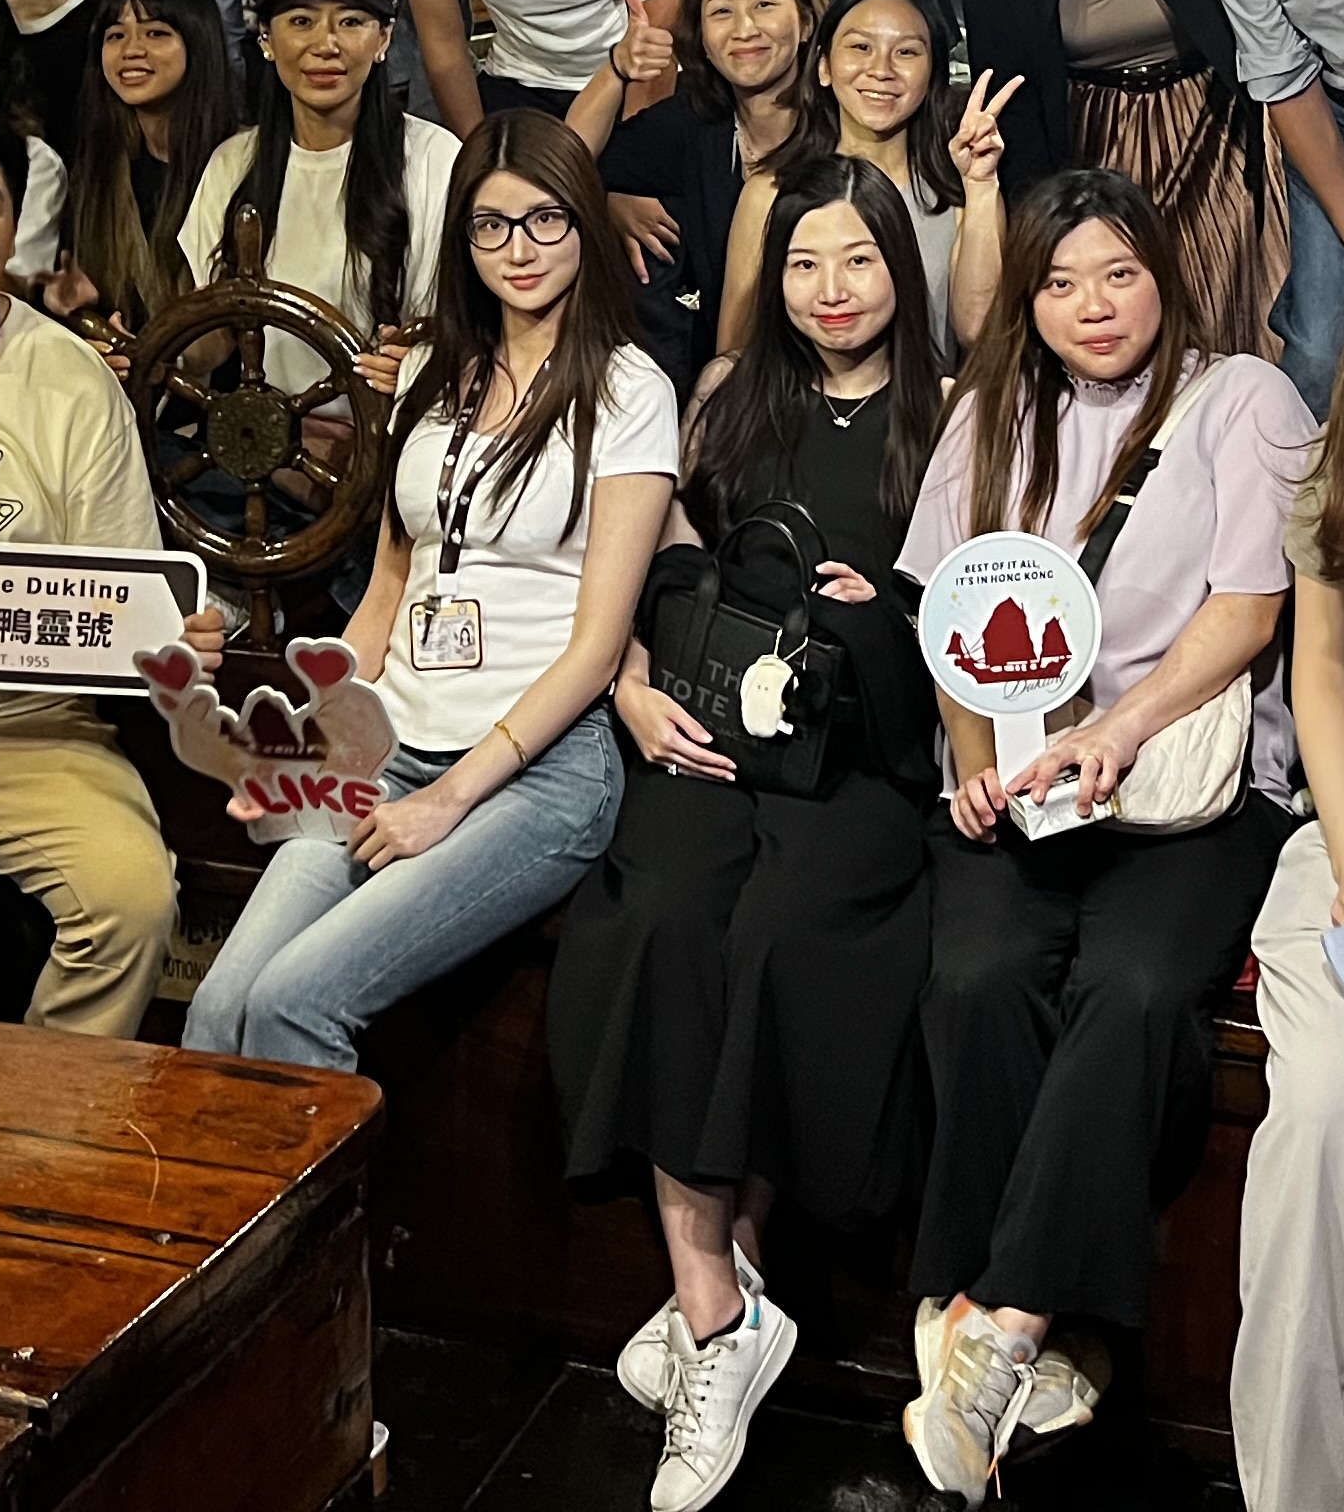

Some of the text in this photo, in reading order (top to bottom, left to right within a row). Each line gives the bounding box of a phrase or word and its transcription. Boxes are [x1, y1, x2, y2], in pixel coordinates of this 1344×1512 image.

[965, 563, 989, 573] BEST
[992, 561, 1004, 571] OF
[1008, 560, 1017, 569] IT
[977, 576, 987, 584] IN
[991, 573, 1021, 583] HONG
[1024, 570, 1054, 580] KONG
[26, 576, 130, 603] Dukling
[20, 655, 50, 668] 1955
[708, 658, 743, 693] TH
[661, 668, 729, 718] TOTE
[244, 774, 381, 820] LIKE
